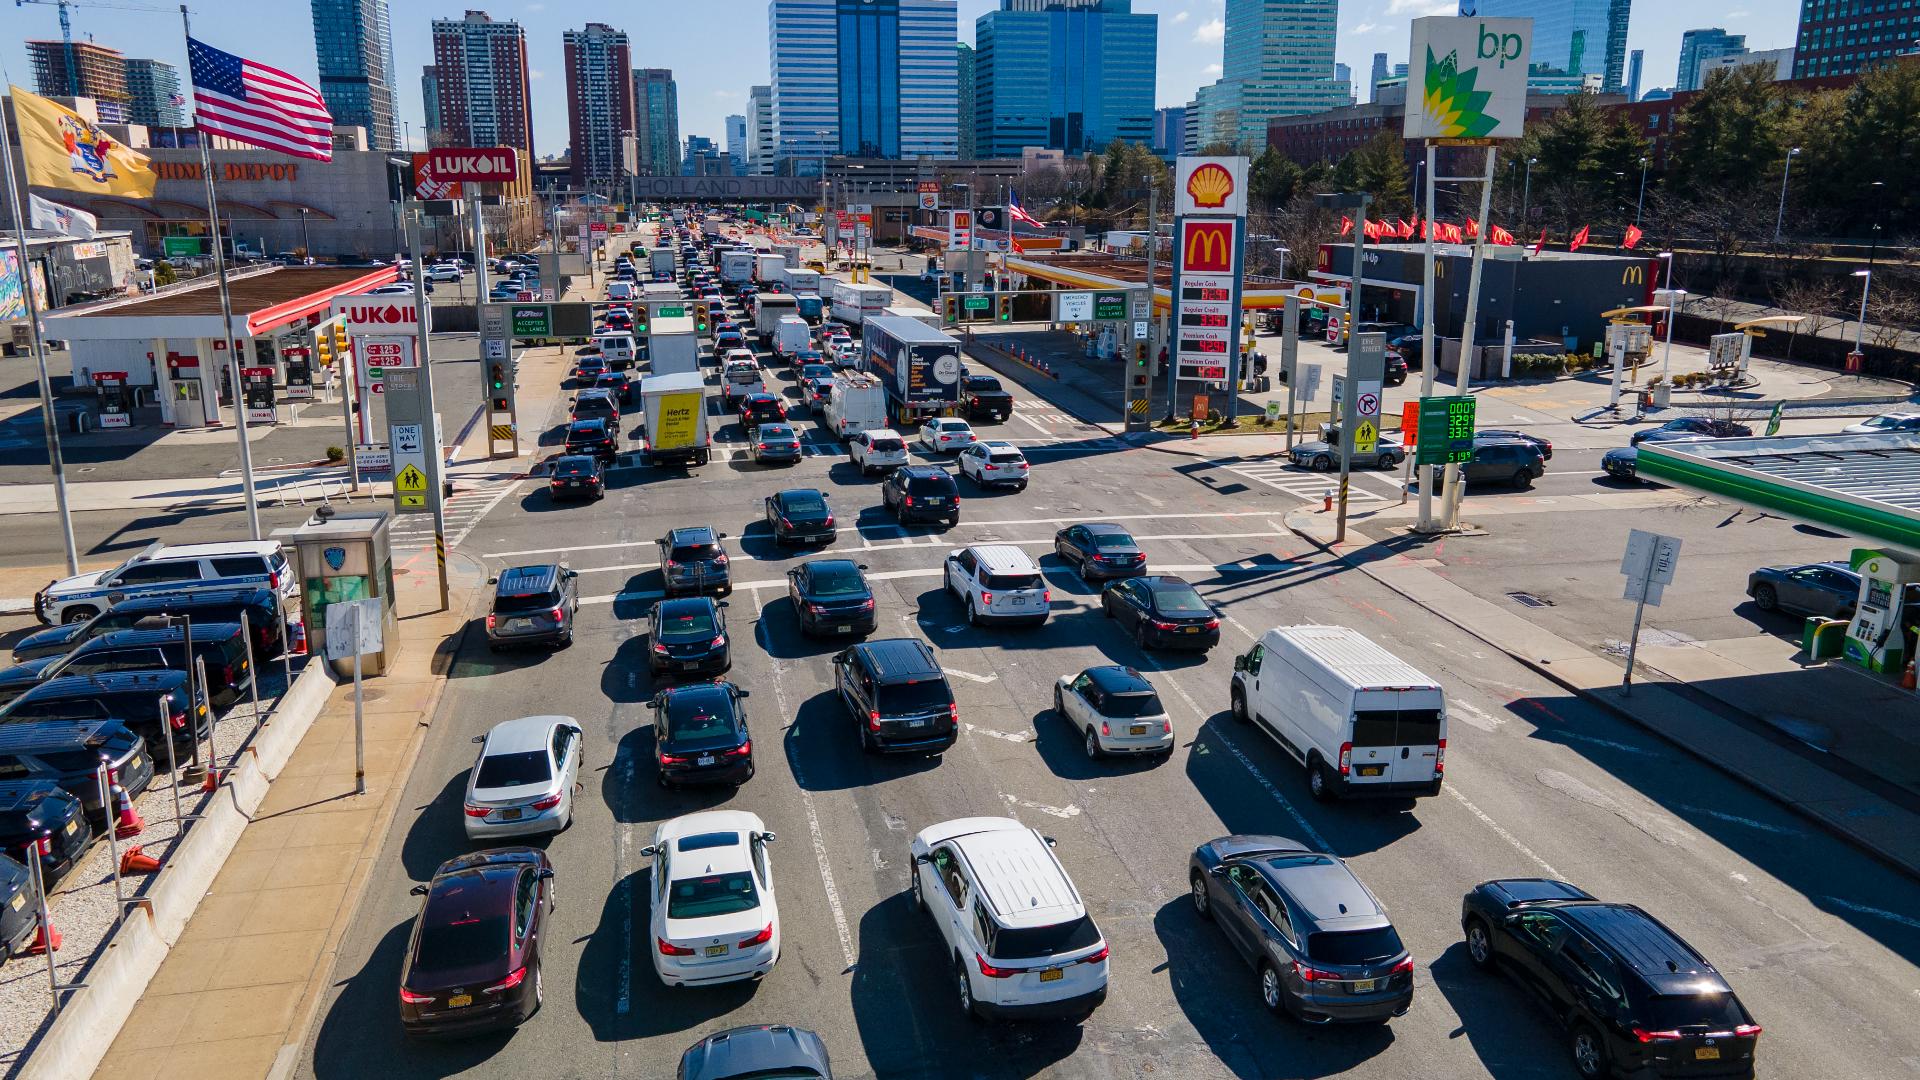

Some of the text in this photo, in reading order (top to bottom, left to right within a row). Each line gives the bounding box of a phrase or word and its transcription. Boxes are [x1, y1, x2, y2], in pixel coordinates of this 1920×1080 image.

[1477, 24, 1523, 69] bp
[435, 154, 511, 174] LUKOIL
[223, 162, 299, 181] DEPOT
[637, 179, 824, 196] HOLLAND TUNNE
[1184, 280, 1203, 288] Regular
[1204, 358, 1220, 366] Credit
[667, 408, 690, 417] Hertz
[398, 426, 416, 434] ONE
[399, 433, 417, 442] WAY
[67, 592, 92, 601] POLICE
